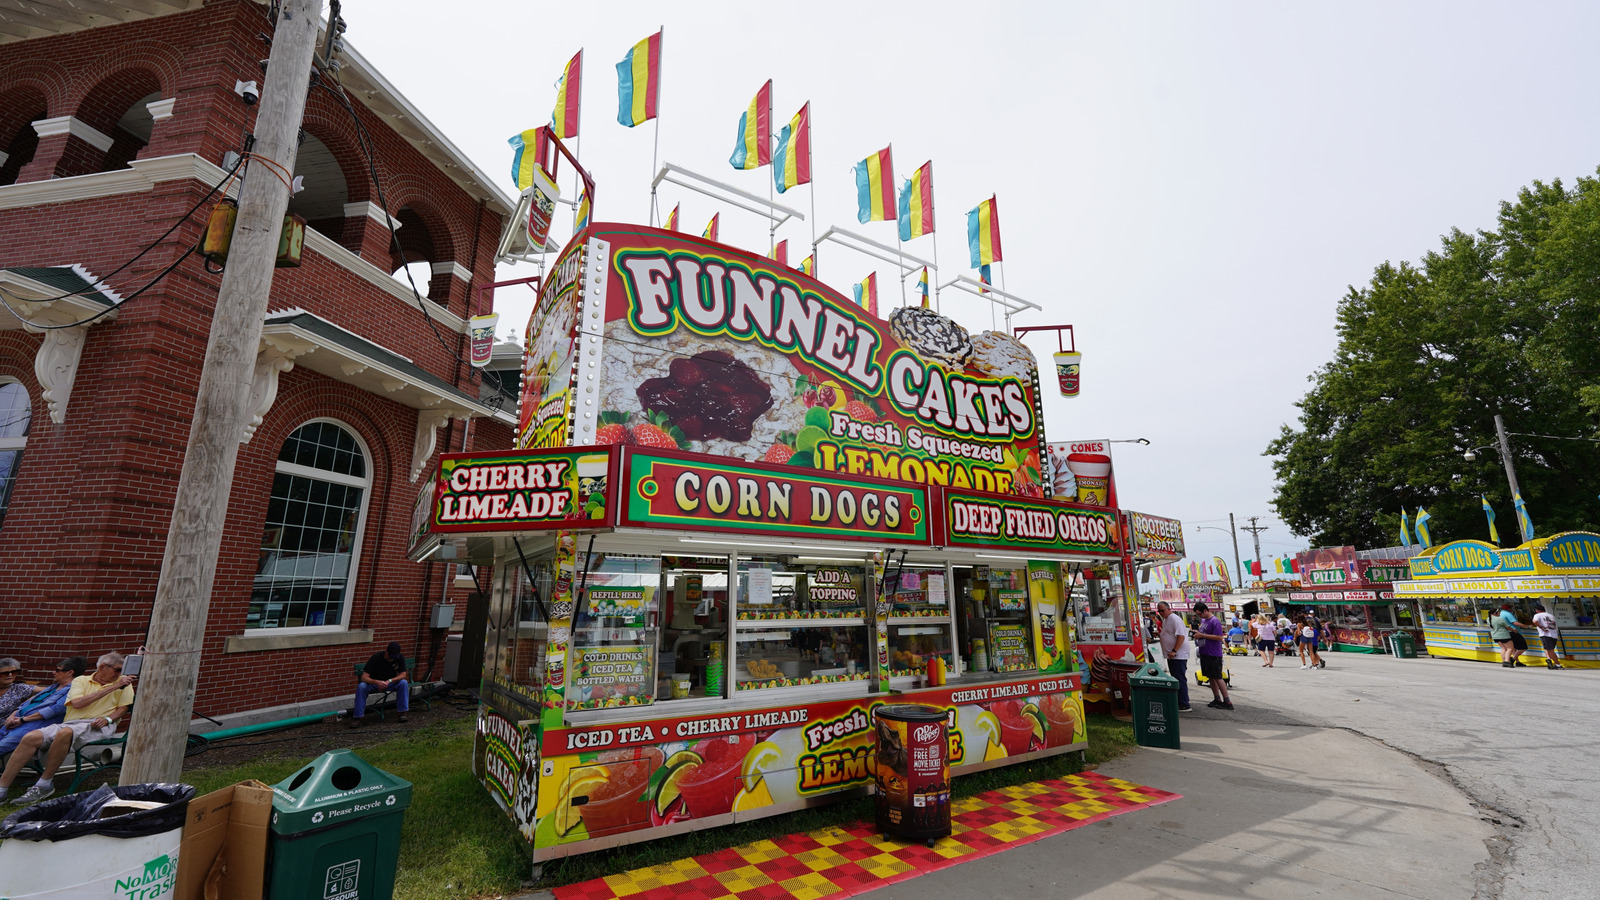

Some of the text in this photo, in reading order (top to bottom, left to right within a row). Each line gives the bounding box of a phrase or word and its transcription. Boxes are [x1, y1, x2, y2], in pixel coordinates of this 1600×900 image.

[624, 257, 1031, 436] FUNNEL CAKES
[831, 412, 1004, 463] Fresh Squeezed
[1071, 443, 1103, 452] CONES
[450, 462, 568, 492] CHERRY
[820, 443, 1013, 494] LEMONADE
[440, 491, 570, 521] LIMEADE
[674, 471, 901, 529] CORN DOGS
[952, 502, 1106, 543] DEEP FRIED OREOS
[1135, 515, 1180, 539] ROOTBEER
[1147, 538, 1175, 552] FLOATS
[1552, 540, 1600, 563] CORN DO
[1438, 546, 1492, 570] CORN DOGS
[1503, 552, 1530, 568] NACHOS
[1030, 570, 1054, 580] REFILLS
[1411, 561, 1431, 574] NACHOS
[816, 570, 851, 584] ADD A
[1312, 571, 1342, 583] PIZZA
[1451, 581, 1508, 591] LEMONADE
[592, 591, 642, 599] REFILL HERE
[810, 587, 857, 601] TOPPING
[1125, 562, 1140, 637] FLOATS
[584, 652, 643, 662] COLD DRINKS
[592, 664, 633, 674] ICED TEA
[577, 675, 645, 685] BOTTLED WATER
[951, 679, 1074, 703] CHERRY LIMEADE ICED TEA
[566, 708, 809, 750] ICED TEA CHERRY LIMEADE
[806, 709, 868, 750] Fresh
[917, 727, 939, 742] Pepper
[923, 724, 933, 734] Dr
[486, 715, 522, 762] FUNNEL
[914, 751, 928, 760] FREE
[914, 758, 941, 768] MOVIE TICKET
[486, 752, 514, 798] CAKES
[314, 792, 343, 803] ALUMINUM
[348, 787, 369, 796] PLASTIC
[369, 784, 383, 792] ONLY
[328, 800, 382, 818] Please Recycle
[114, 857, 178, 894] No MOR
